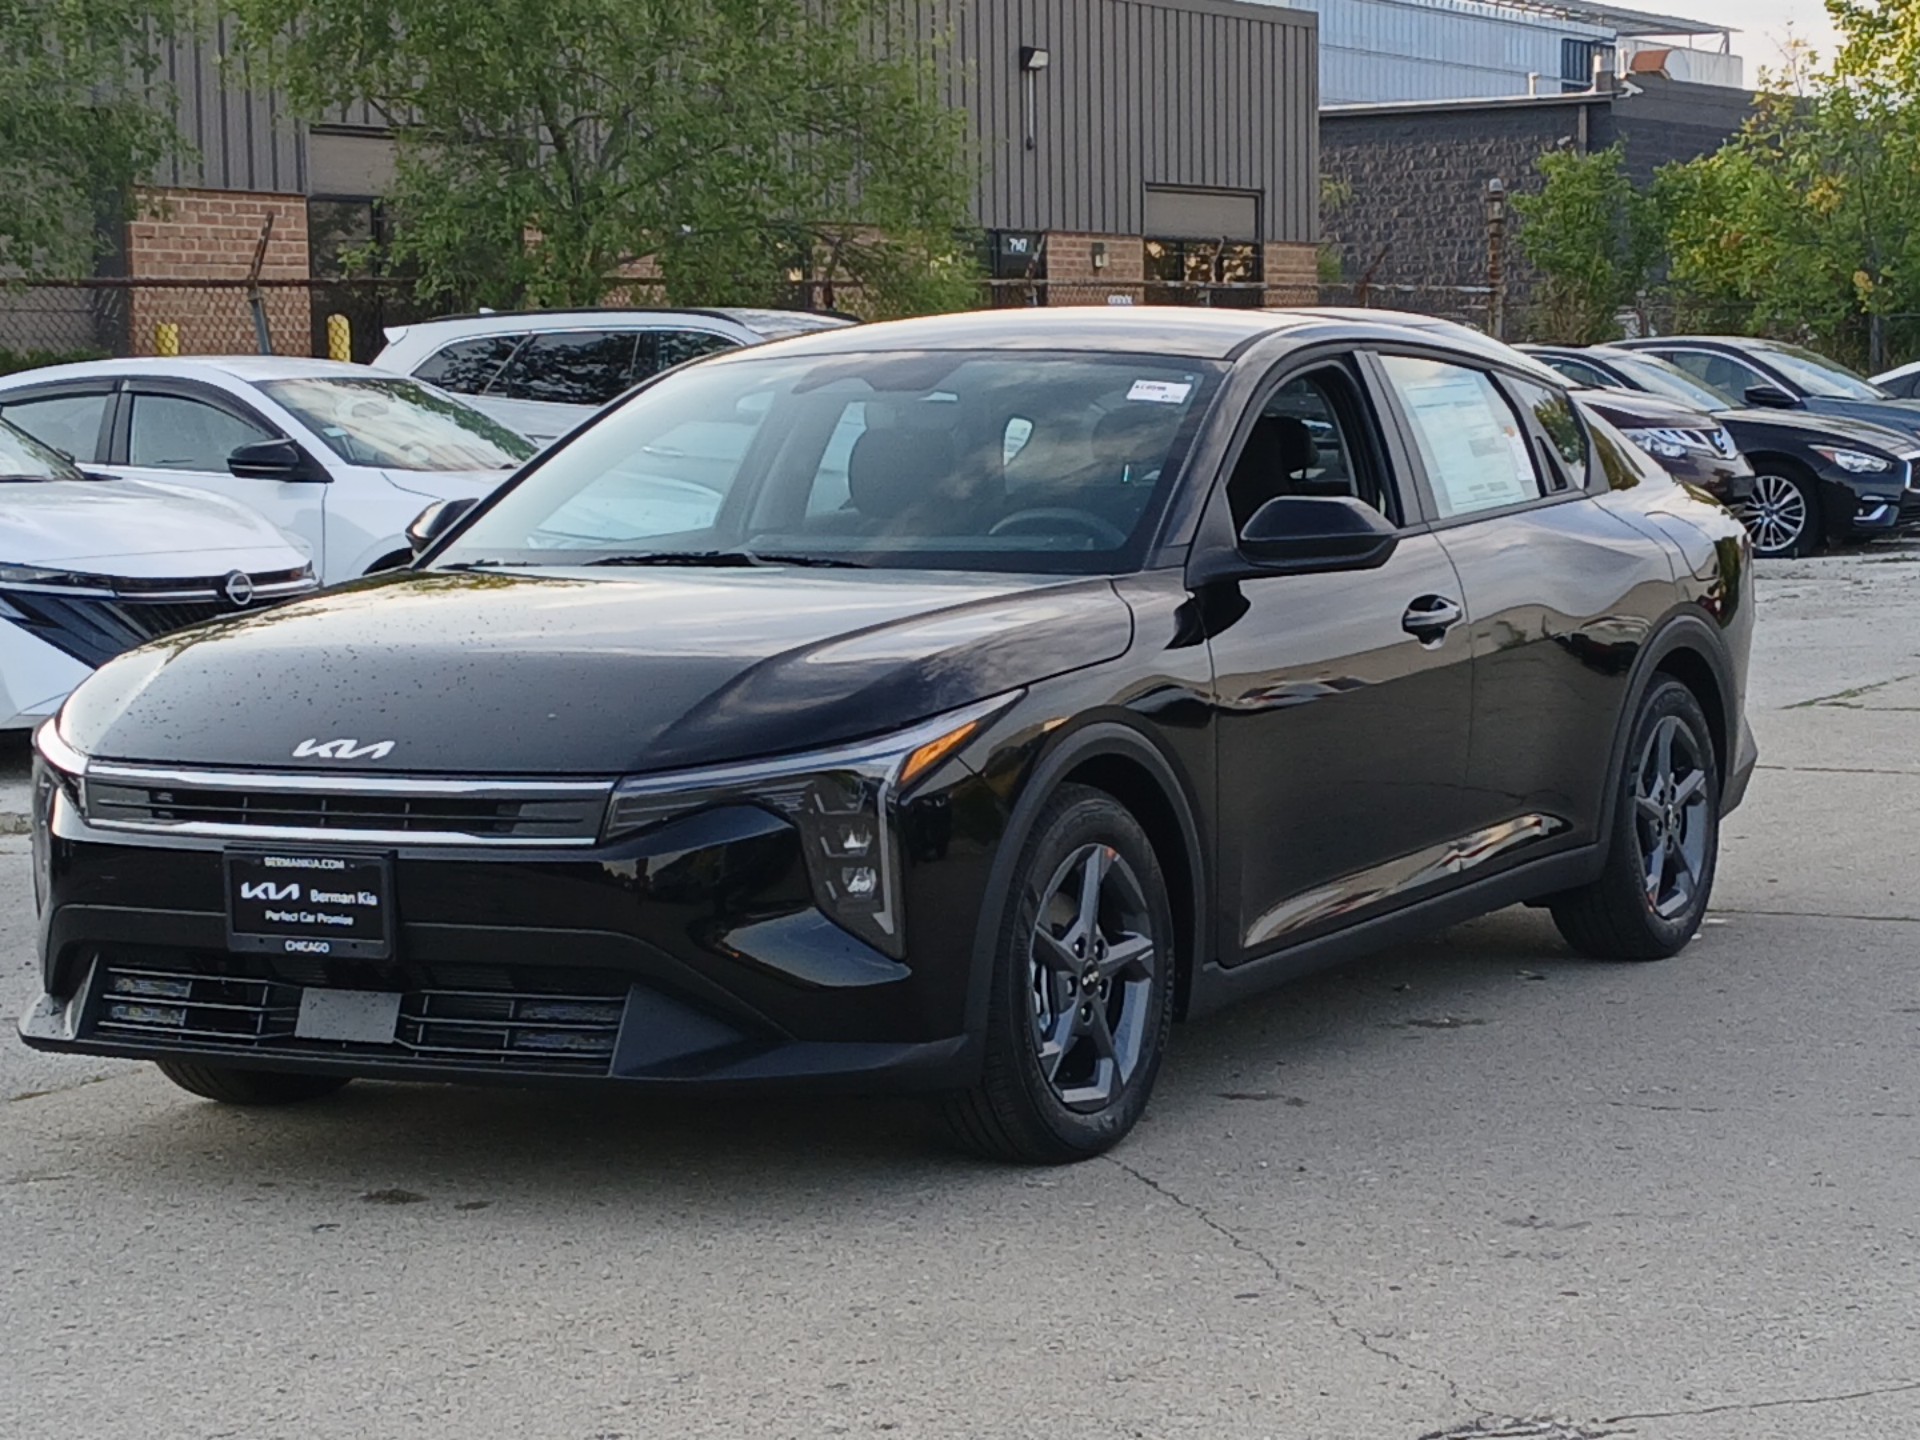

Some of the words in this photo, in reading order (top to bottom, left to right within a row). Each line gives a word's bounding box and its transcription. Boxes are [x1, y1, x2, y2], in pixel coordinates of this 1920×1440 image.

[292, 738, 395, 759] KIA
[240, 882, 300, 900] KIA
[310, 889, 356, 904] Berman
[357, 891, 378, 905] Kia
[265, 910, 298, 922] Perfect
[300, 911, 315, 923] Car
[317, 913, 353, 925] Promise
[284, 940, 330, 952] CHICAGO
